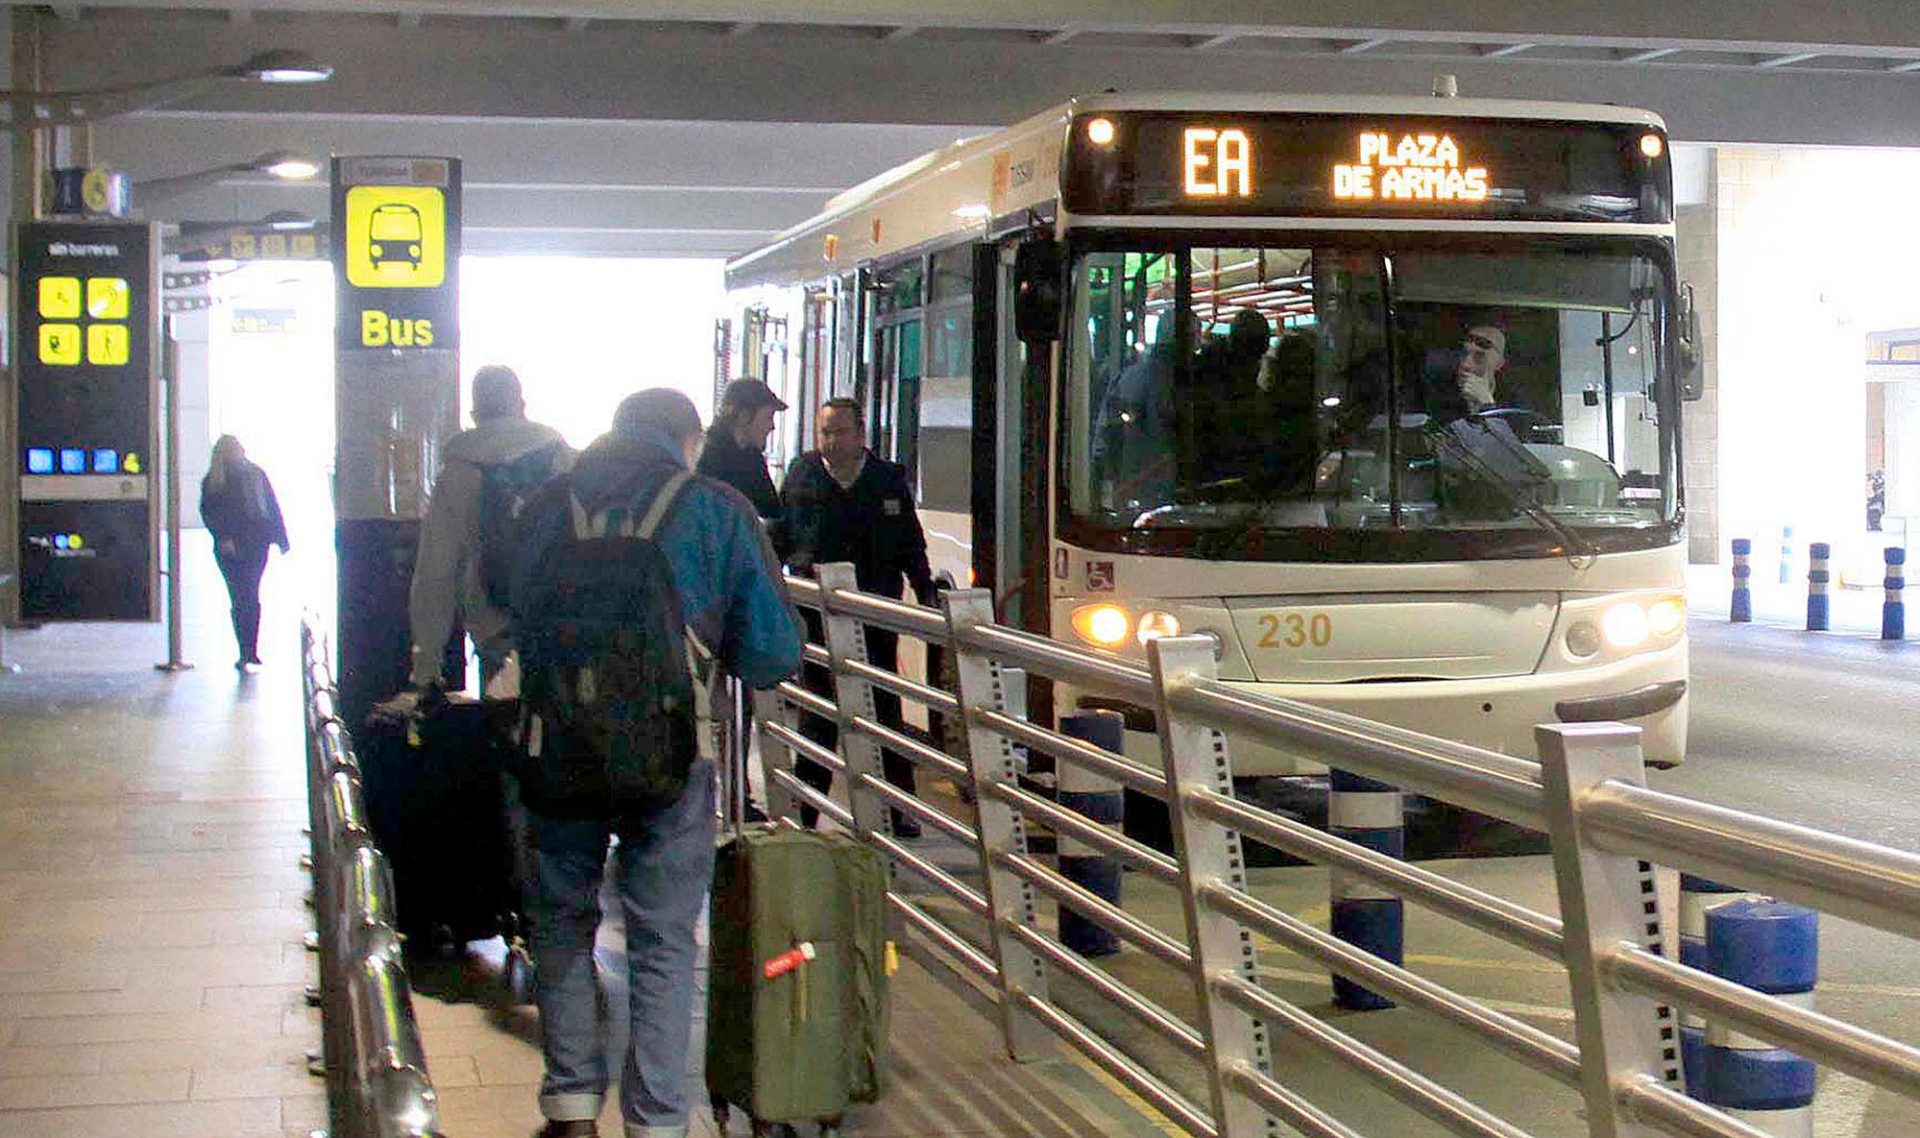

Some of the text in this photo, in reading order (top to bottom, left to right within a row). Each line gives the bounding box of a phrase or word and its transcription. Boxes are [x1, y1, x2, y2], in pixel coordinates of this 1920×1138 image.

[1183, 127, 1251, 197] EA
[1358, 132, 1460, 167] PLAZA
[1332, 164, 1488, 200] DE ARMAS
[361, 309, 434, 347] Bus
[1257, 611, 1332, 649] 230
